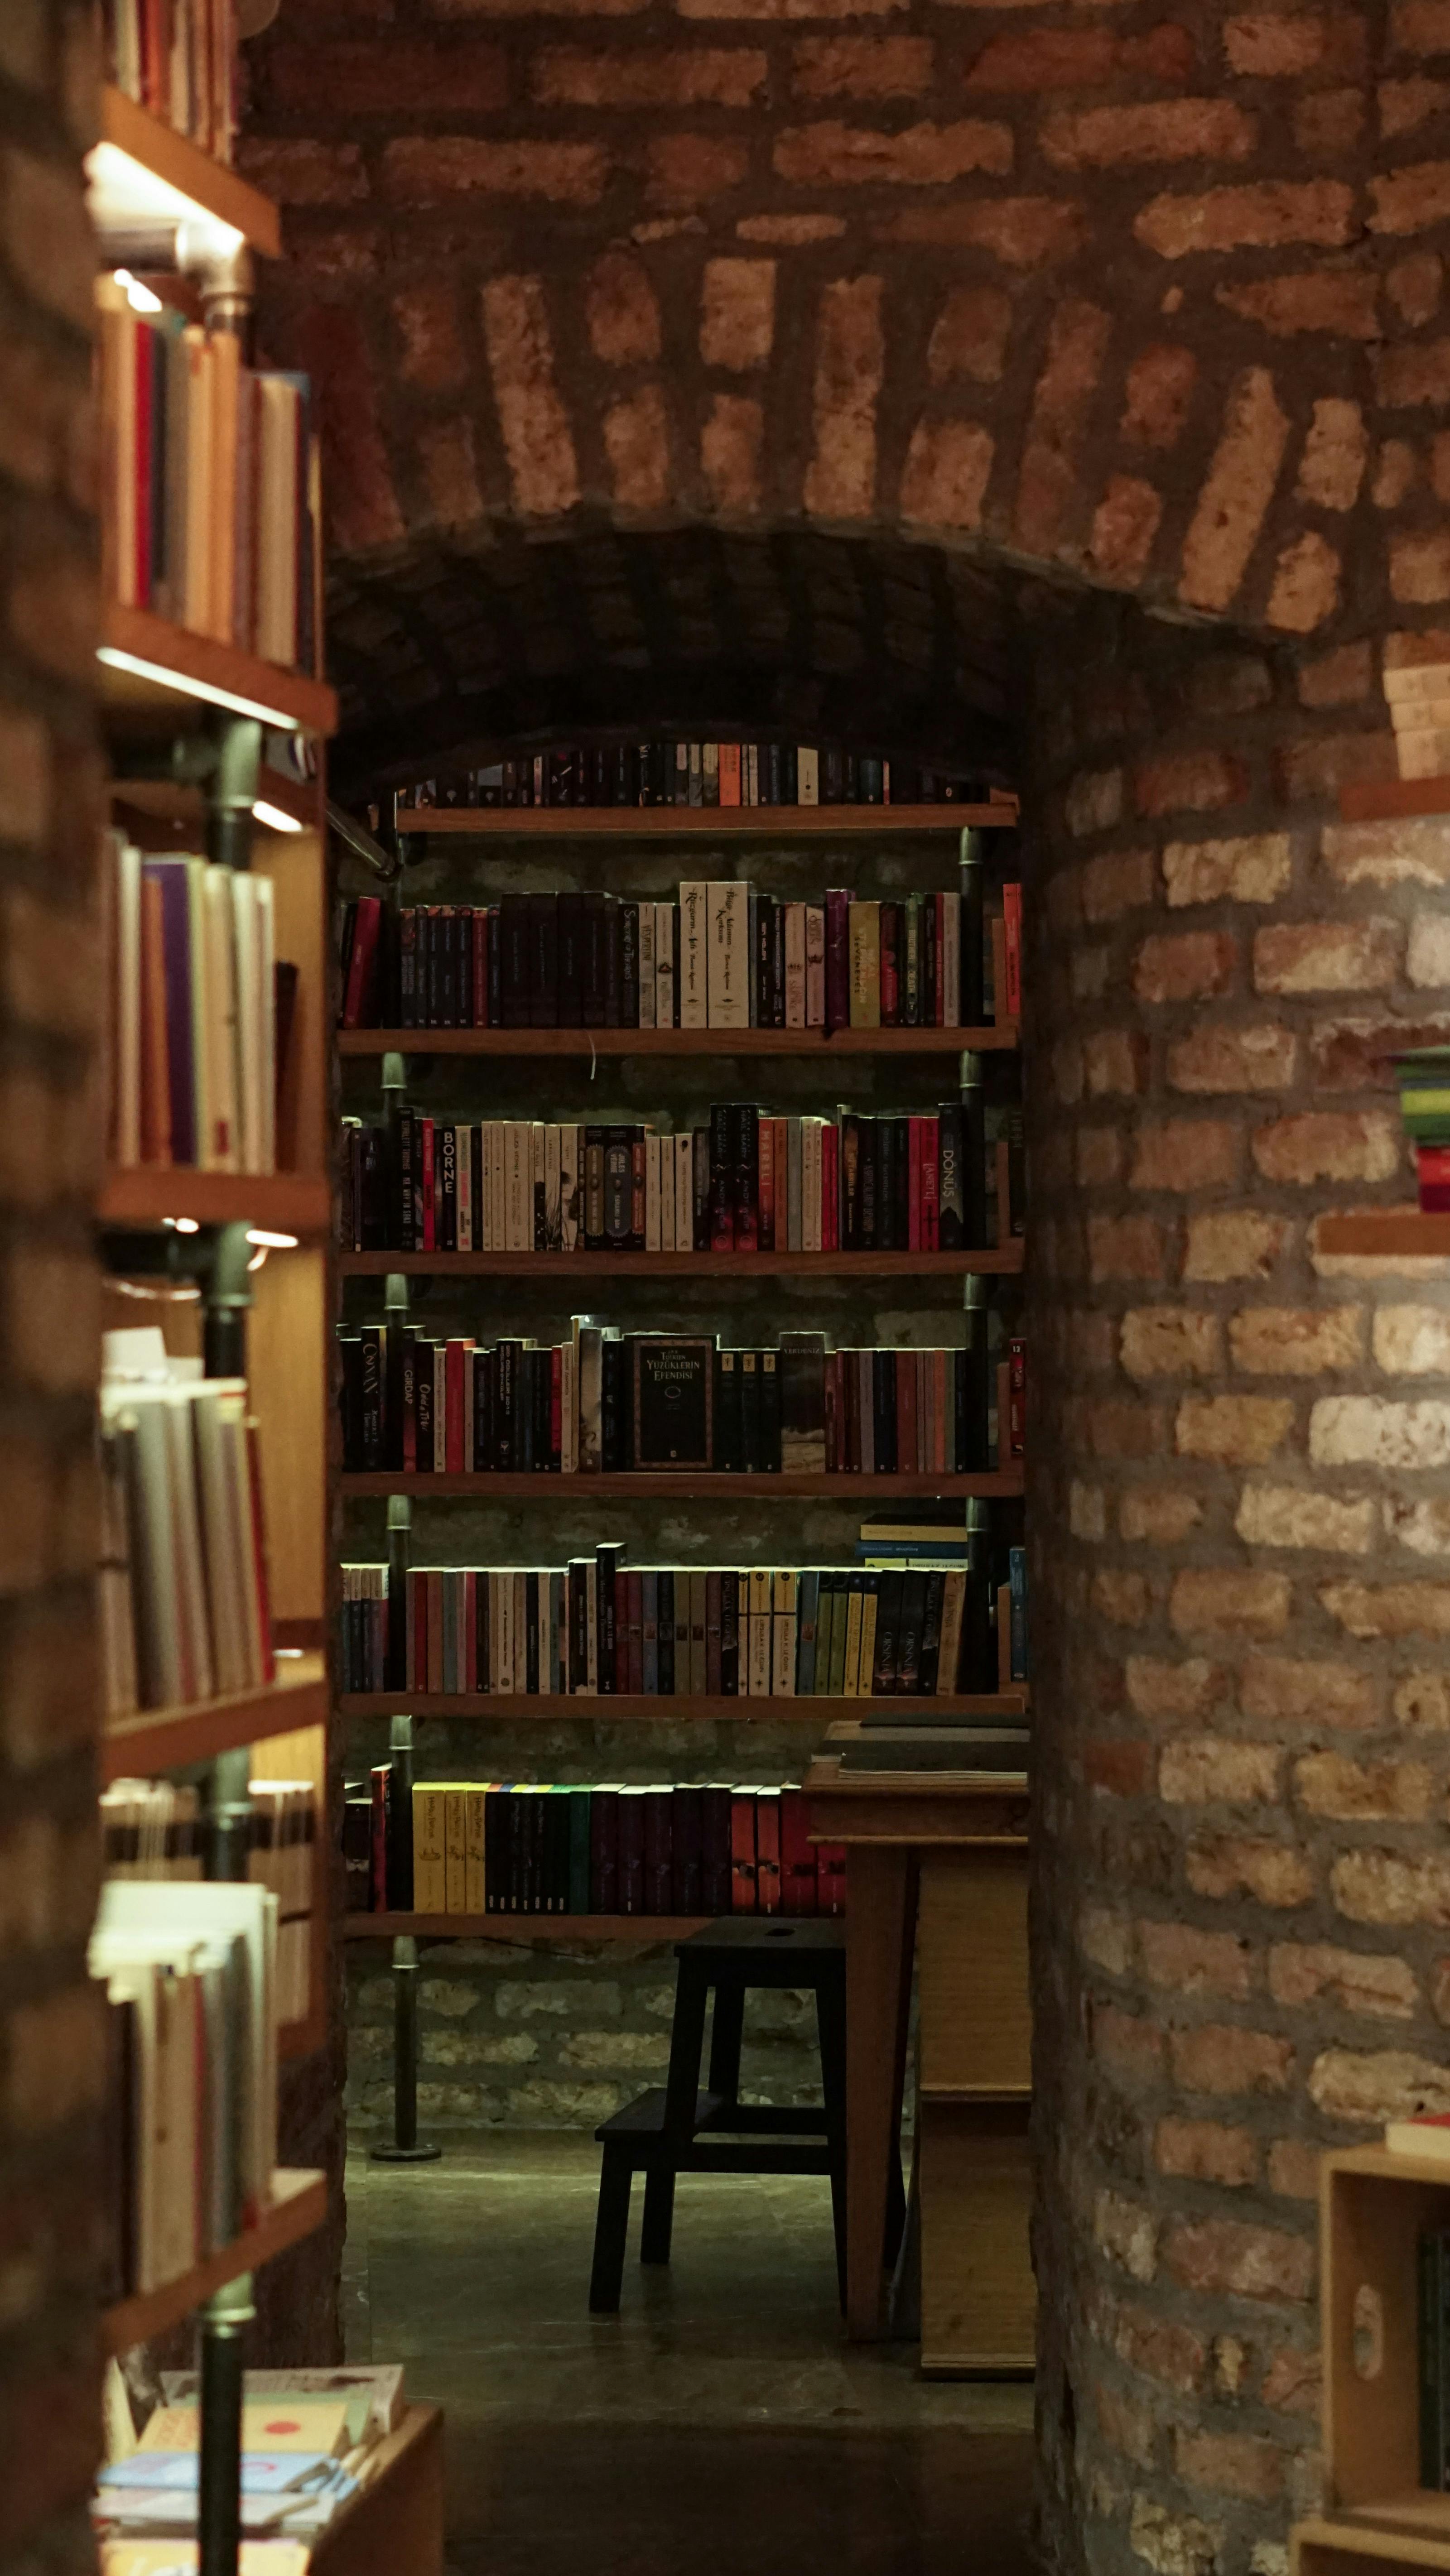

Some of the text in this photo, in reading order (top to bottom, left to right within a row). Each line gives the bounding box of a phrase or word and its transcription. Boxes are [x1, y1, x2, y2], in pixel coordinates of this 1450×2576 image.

[443, 1131, 455, 1194] BORNE
[761, 1130, 771, 1187] MARSLI
[942, 1149, 958, 1197] DÖNÜŞ
[646, 1359, 700, 1370] YÜZÜKLERİN
[654, 1370, 693, 1381] EFENDİSİ
[404, 1370, 414, 1405] GİRDAP
[881, 1631, 892, 1672] ORSINIA
[903, 1631, 915, 1673] ORSINIA
